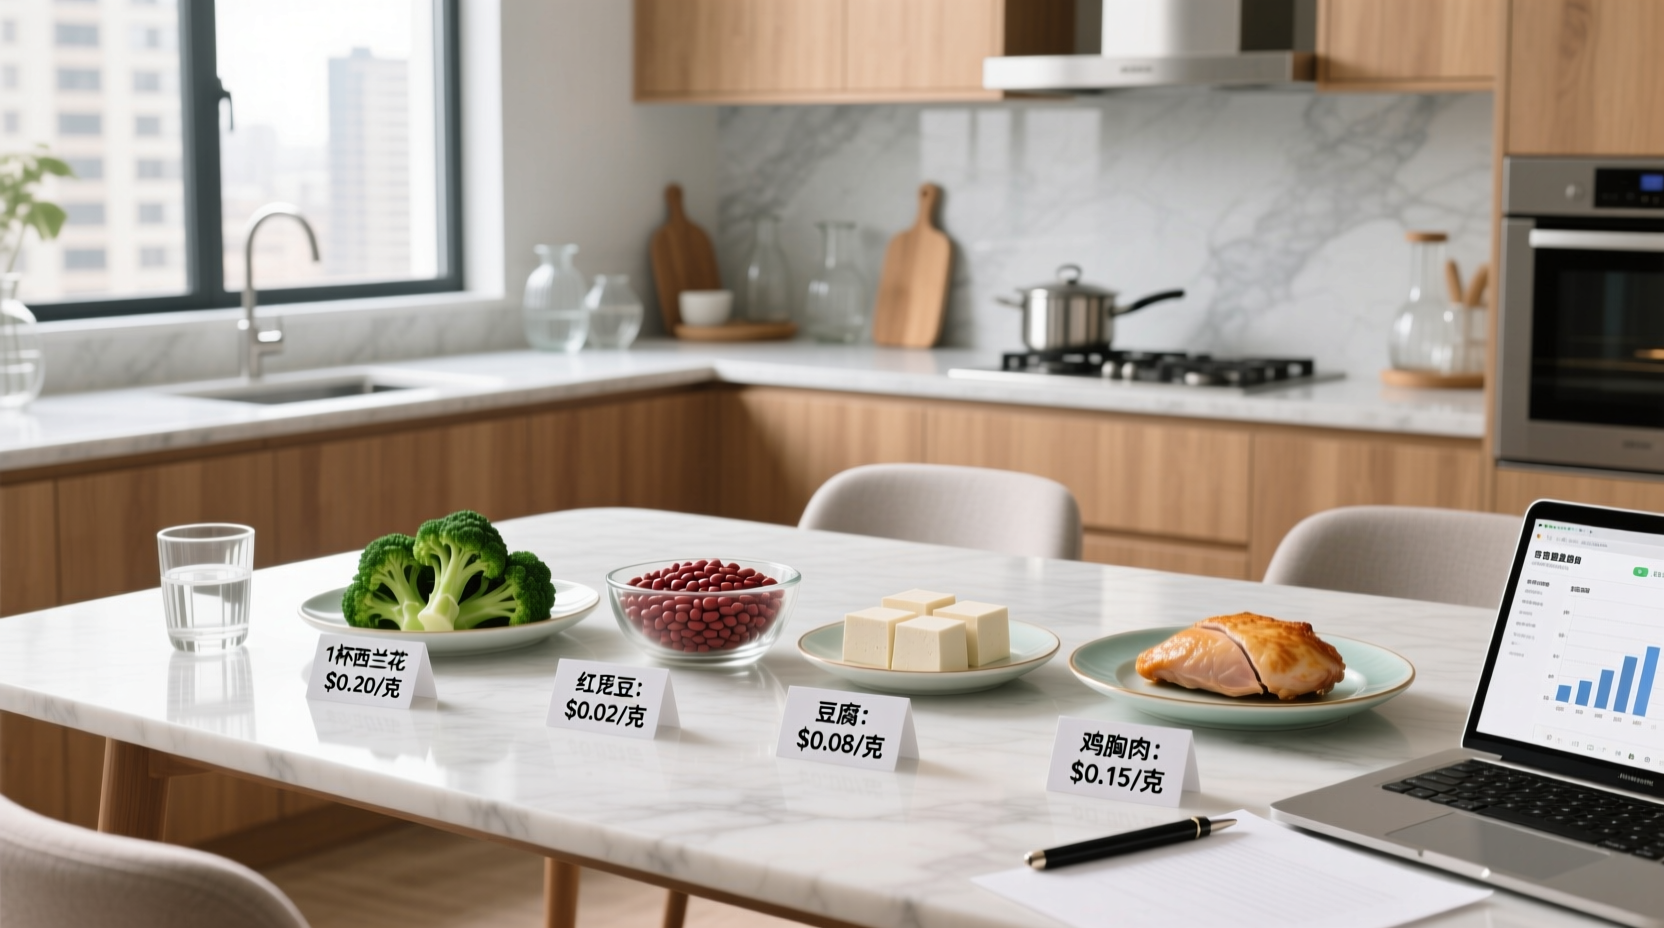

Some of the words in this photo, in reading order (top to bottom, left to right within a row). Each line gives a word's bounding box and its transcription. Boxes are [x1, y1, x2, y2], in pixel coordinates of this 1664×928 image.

[326, 643, 409, 673] 1杯西兰花
[324, 669, 403, 698] $0.20/克
[564, 697, 648, 729] $0.02/克
[796, 725, 886, 760] $0.08/克
[1069, 758, 1166, 795] $0.15/克
